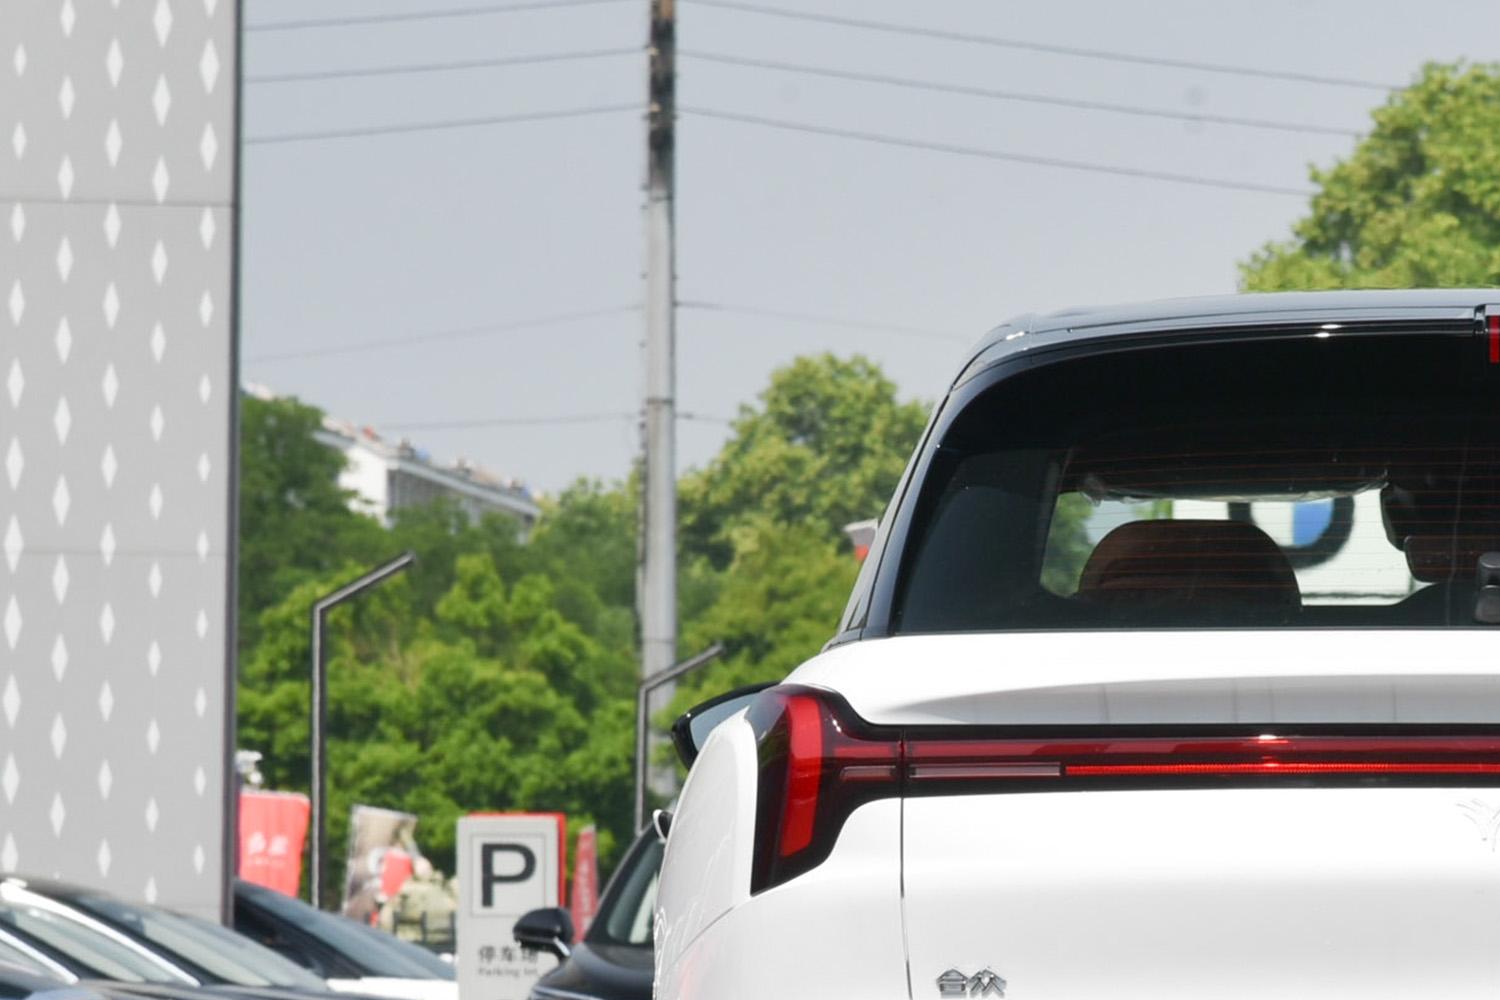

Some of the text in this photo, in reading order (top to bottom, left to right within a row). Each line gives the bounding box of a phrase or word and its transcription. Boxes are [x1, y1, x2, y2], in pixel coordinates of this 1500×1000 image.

[481, 842, 536, 907] P
[479, 946, 538, 964] 停车场
[936, 968, 1007, 995] 合众
